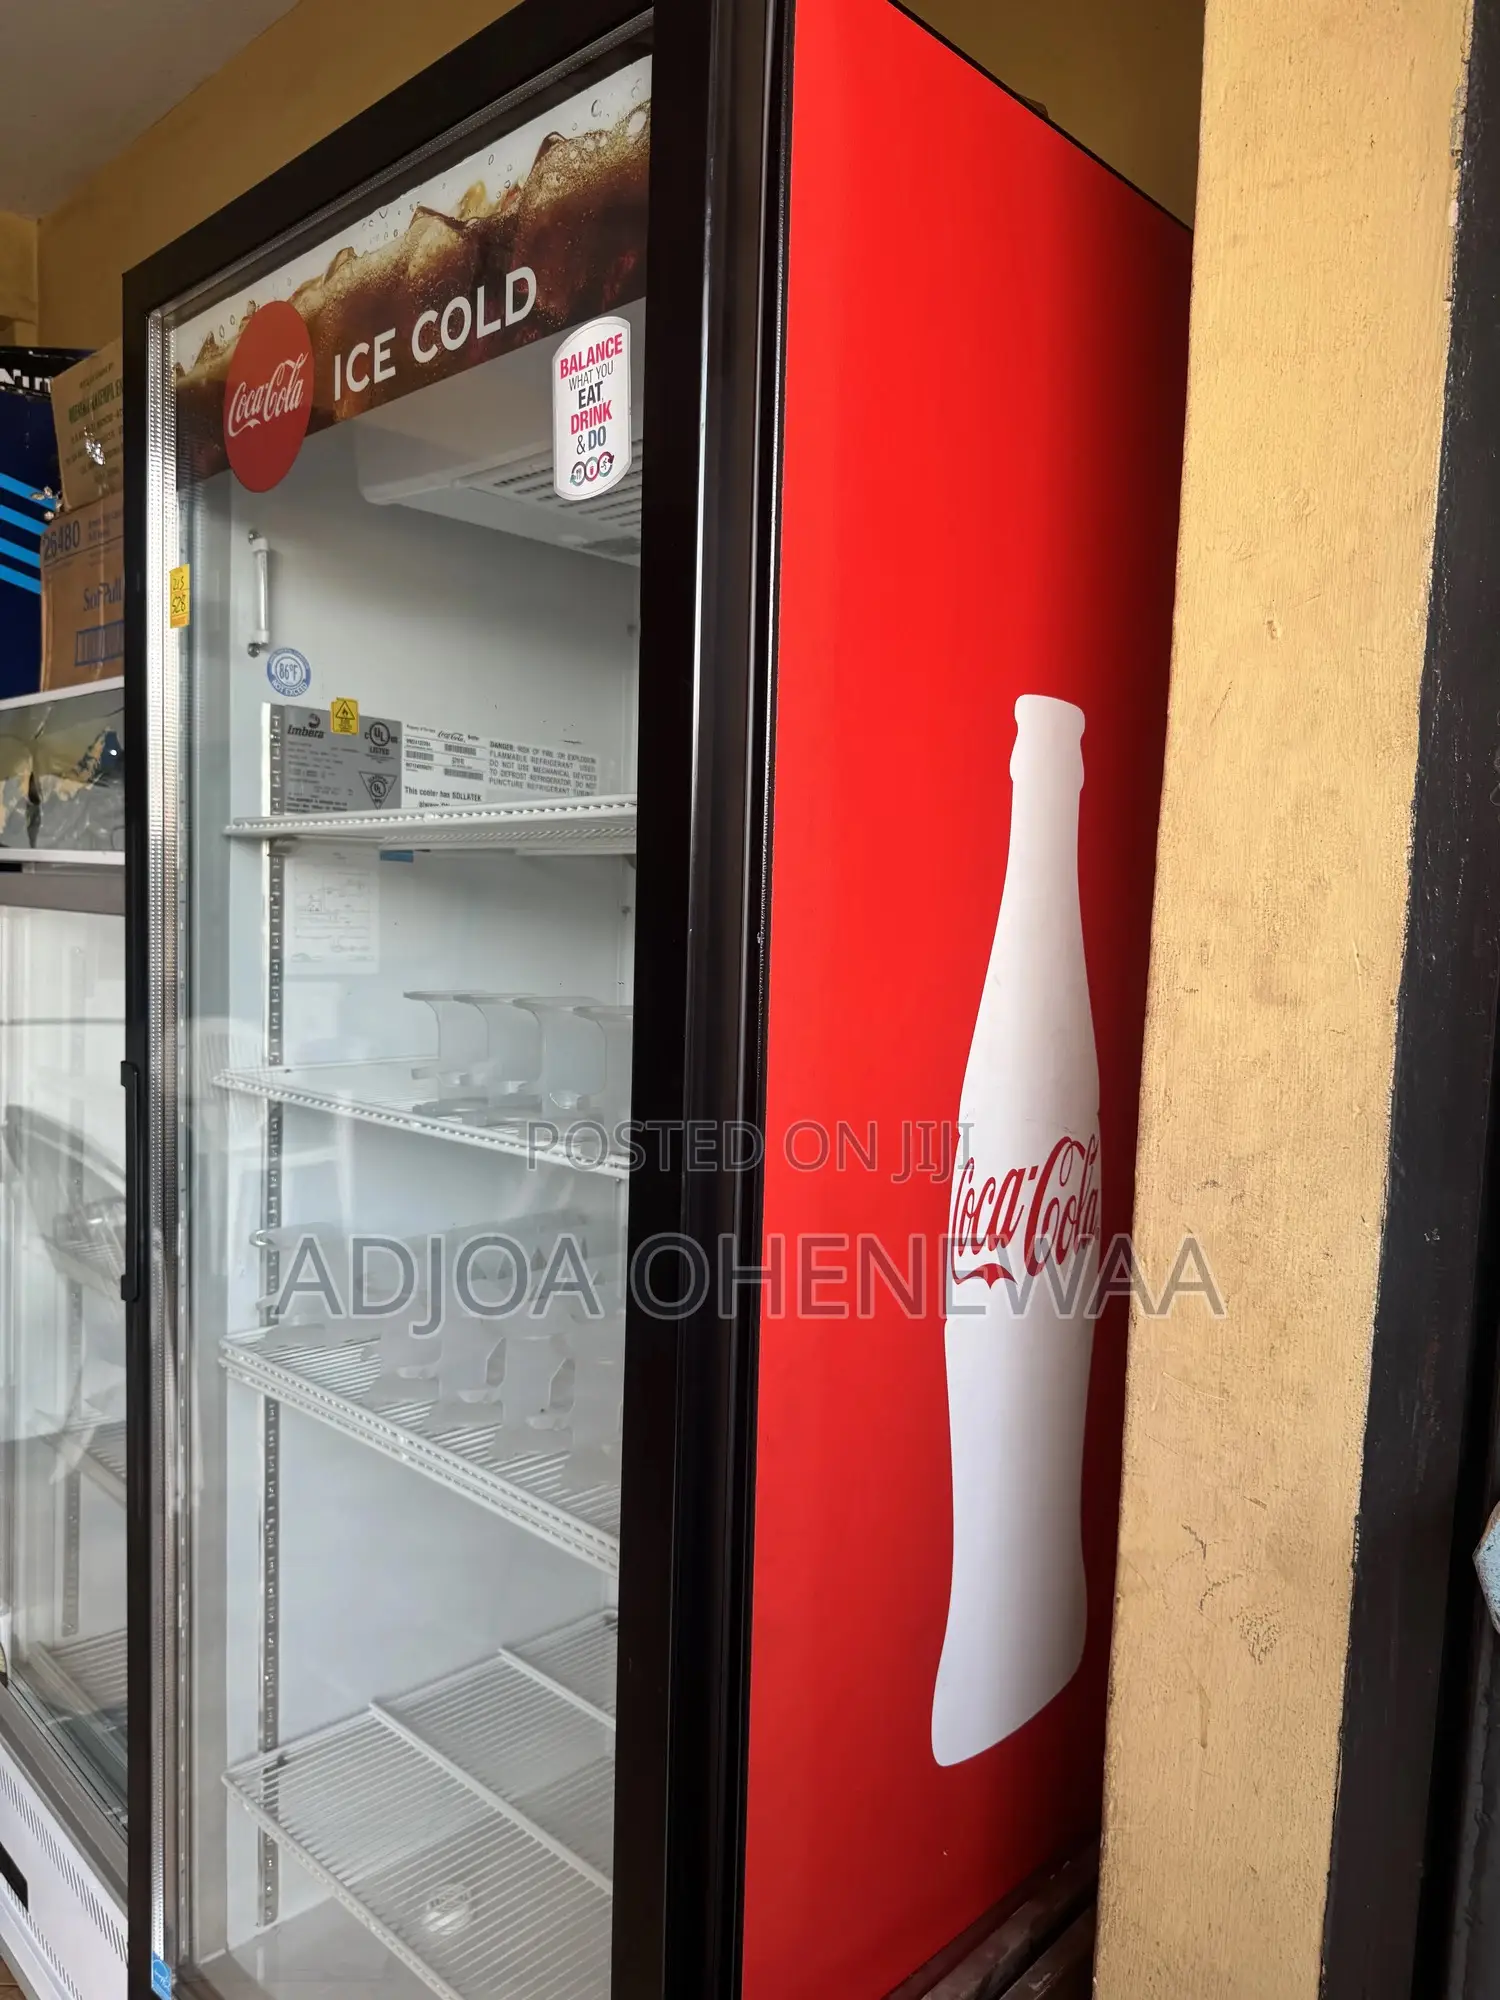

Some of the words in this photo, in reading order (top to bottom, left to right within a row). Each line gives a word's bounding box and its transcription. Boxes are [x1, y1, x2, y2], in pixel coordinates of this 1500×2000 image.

[334, 328, 396, 401] ICE
[411, 266, 537, 364] COLD
[560, 333, 623, 379] BALANCE
[569, 369, 594, 392] WHAT
[596, 360, 614, 381] YOU
[228, 352, 309, 437] Coca-Cola
[571, 400, 612, 435] DRINK
[577, 434, 586, 456] &
[588, 425, 607, 451] DO
[43, 520, 80, 560] 26480
[287, 725, 325, 739] Imbera
[950, 1133, 1099, 1289] Coca-Cola
